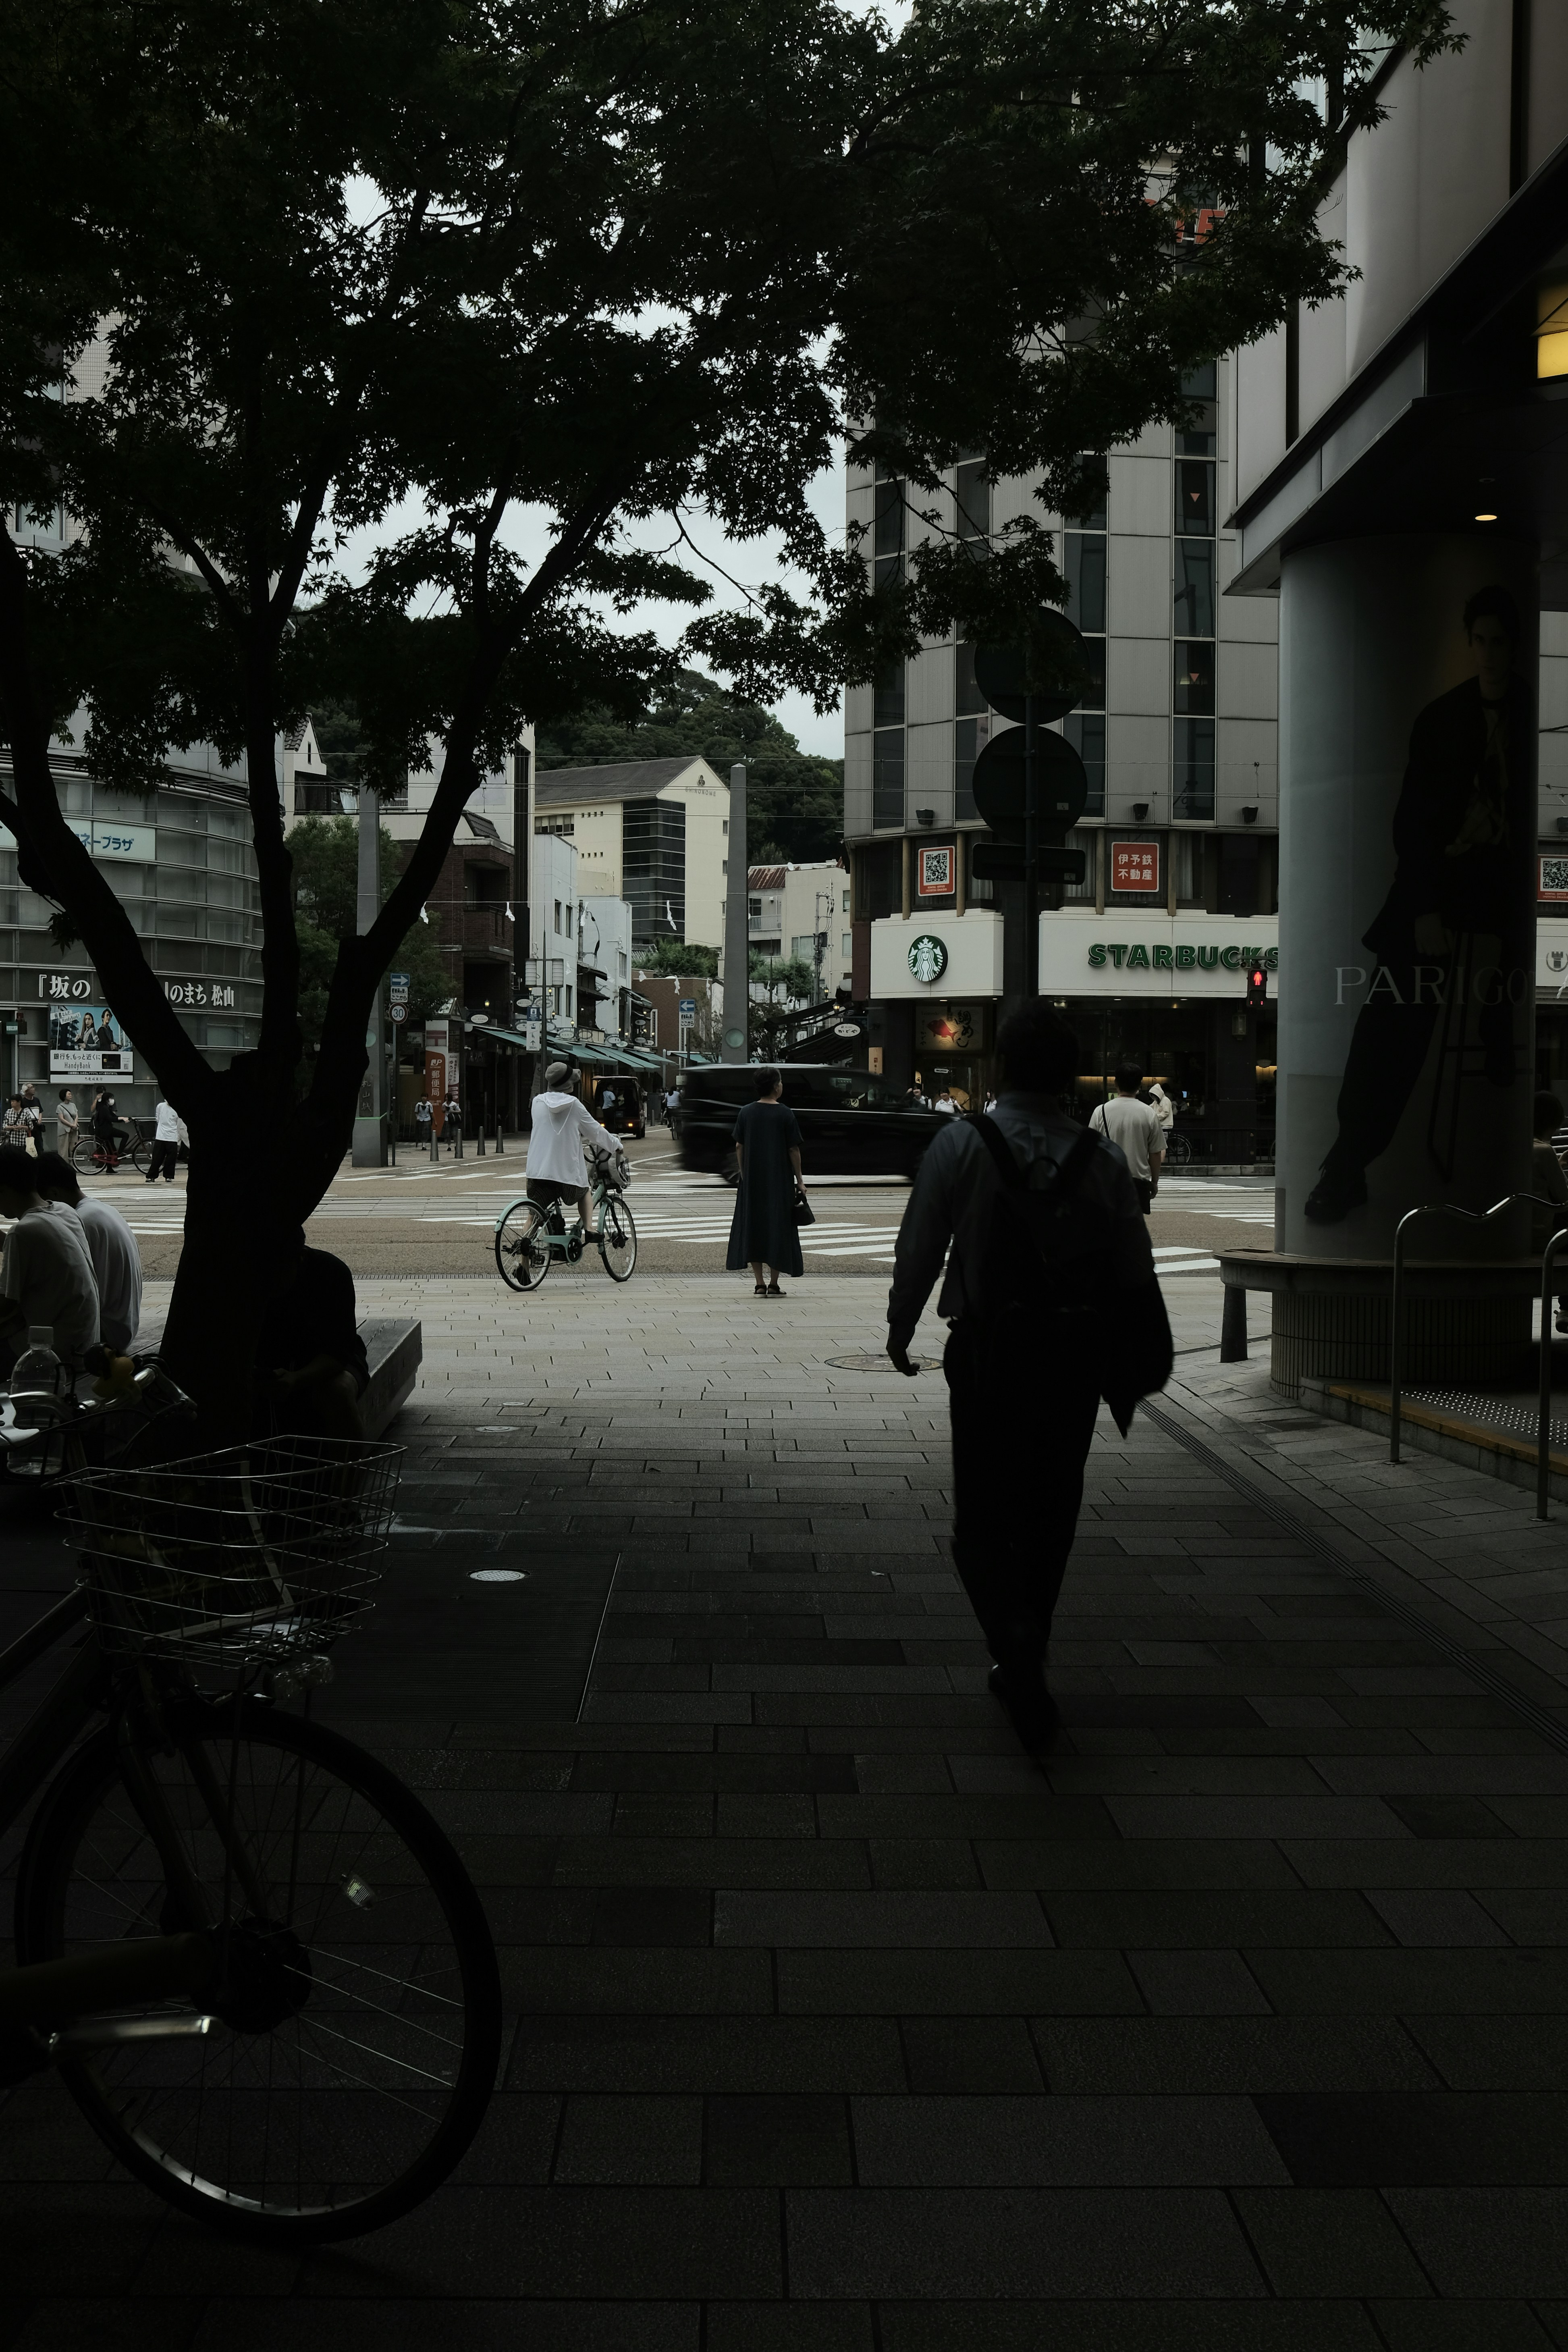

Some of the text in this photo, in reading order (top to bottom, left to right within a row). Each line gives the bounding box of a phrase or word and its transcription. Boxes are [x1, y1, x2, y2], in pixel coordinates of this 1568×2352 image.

[685, 787, 716, 796] SHINONOME
[1118, 854, 1152, 865] 伊予鉄
[1118, 869, 1152, 880] 不動産
[1088, 943, 1278, 969] STARBUCKS
[38, 974, 106, 999] 『坂の
[211, 985, 234, 1007] 松山
[1333, 966, 1535, 1006] PARIGO
[393, 1008, 403, 1018] 30
[64, 1062, 91, 1070] HandyBank
[431, 1070, 440, 1096] 郵便局
